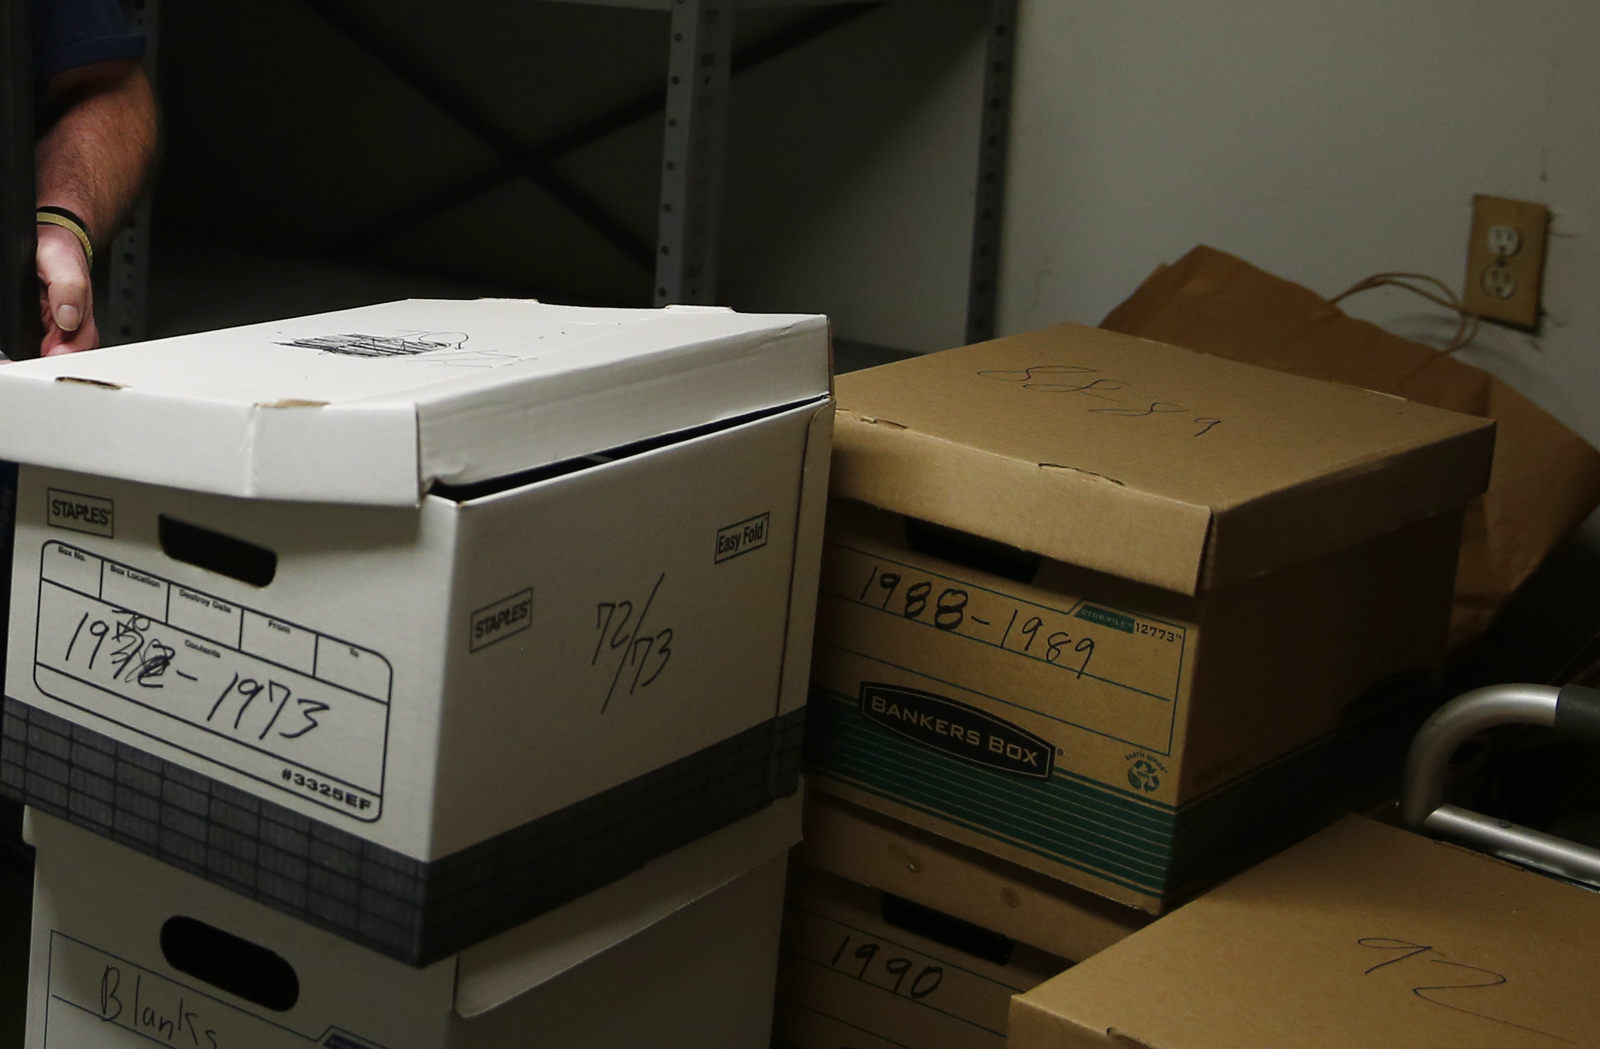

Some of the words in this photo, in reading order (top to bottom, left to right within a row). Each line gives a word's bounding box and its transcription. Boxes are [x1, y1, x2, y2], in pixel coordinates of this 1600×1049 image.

[52, 500, 112, 526] STAPLES
[58, 546, 73, 557] Box
[74, 551, 86, 562] No.
[717, 530, 741, 555] Easy
[743, 521, 764, 545] Fold
[110, 564, 125, 576] Box
[127, 569, 160, 589] Location
[475, 601, 529, 639] STAPLES
[871, 694, 980, 747] BANKERS
[989, 736, 1039, 768] BOX
[282, 769, 372, 811] #3325EF
[831, 935, 944, 1001] 1990
